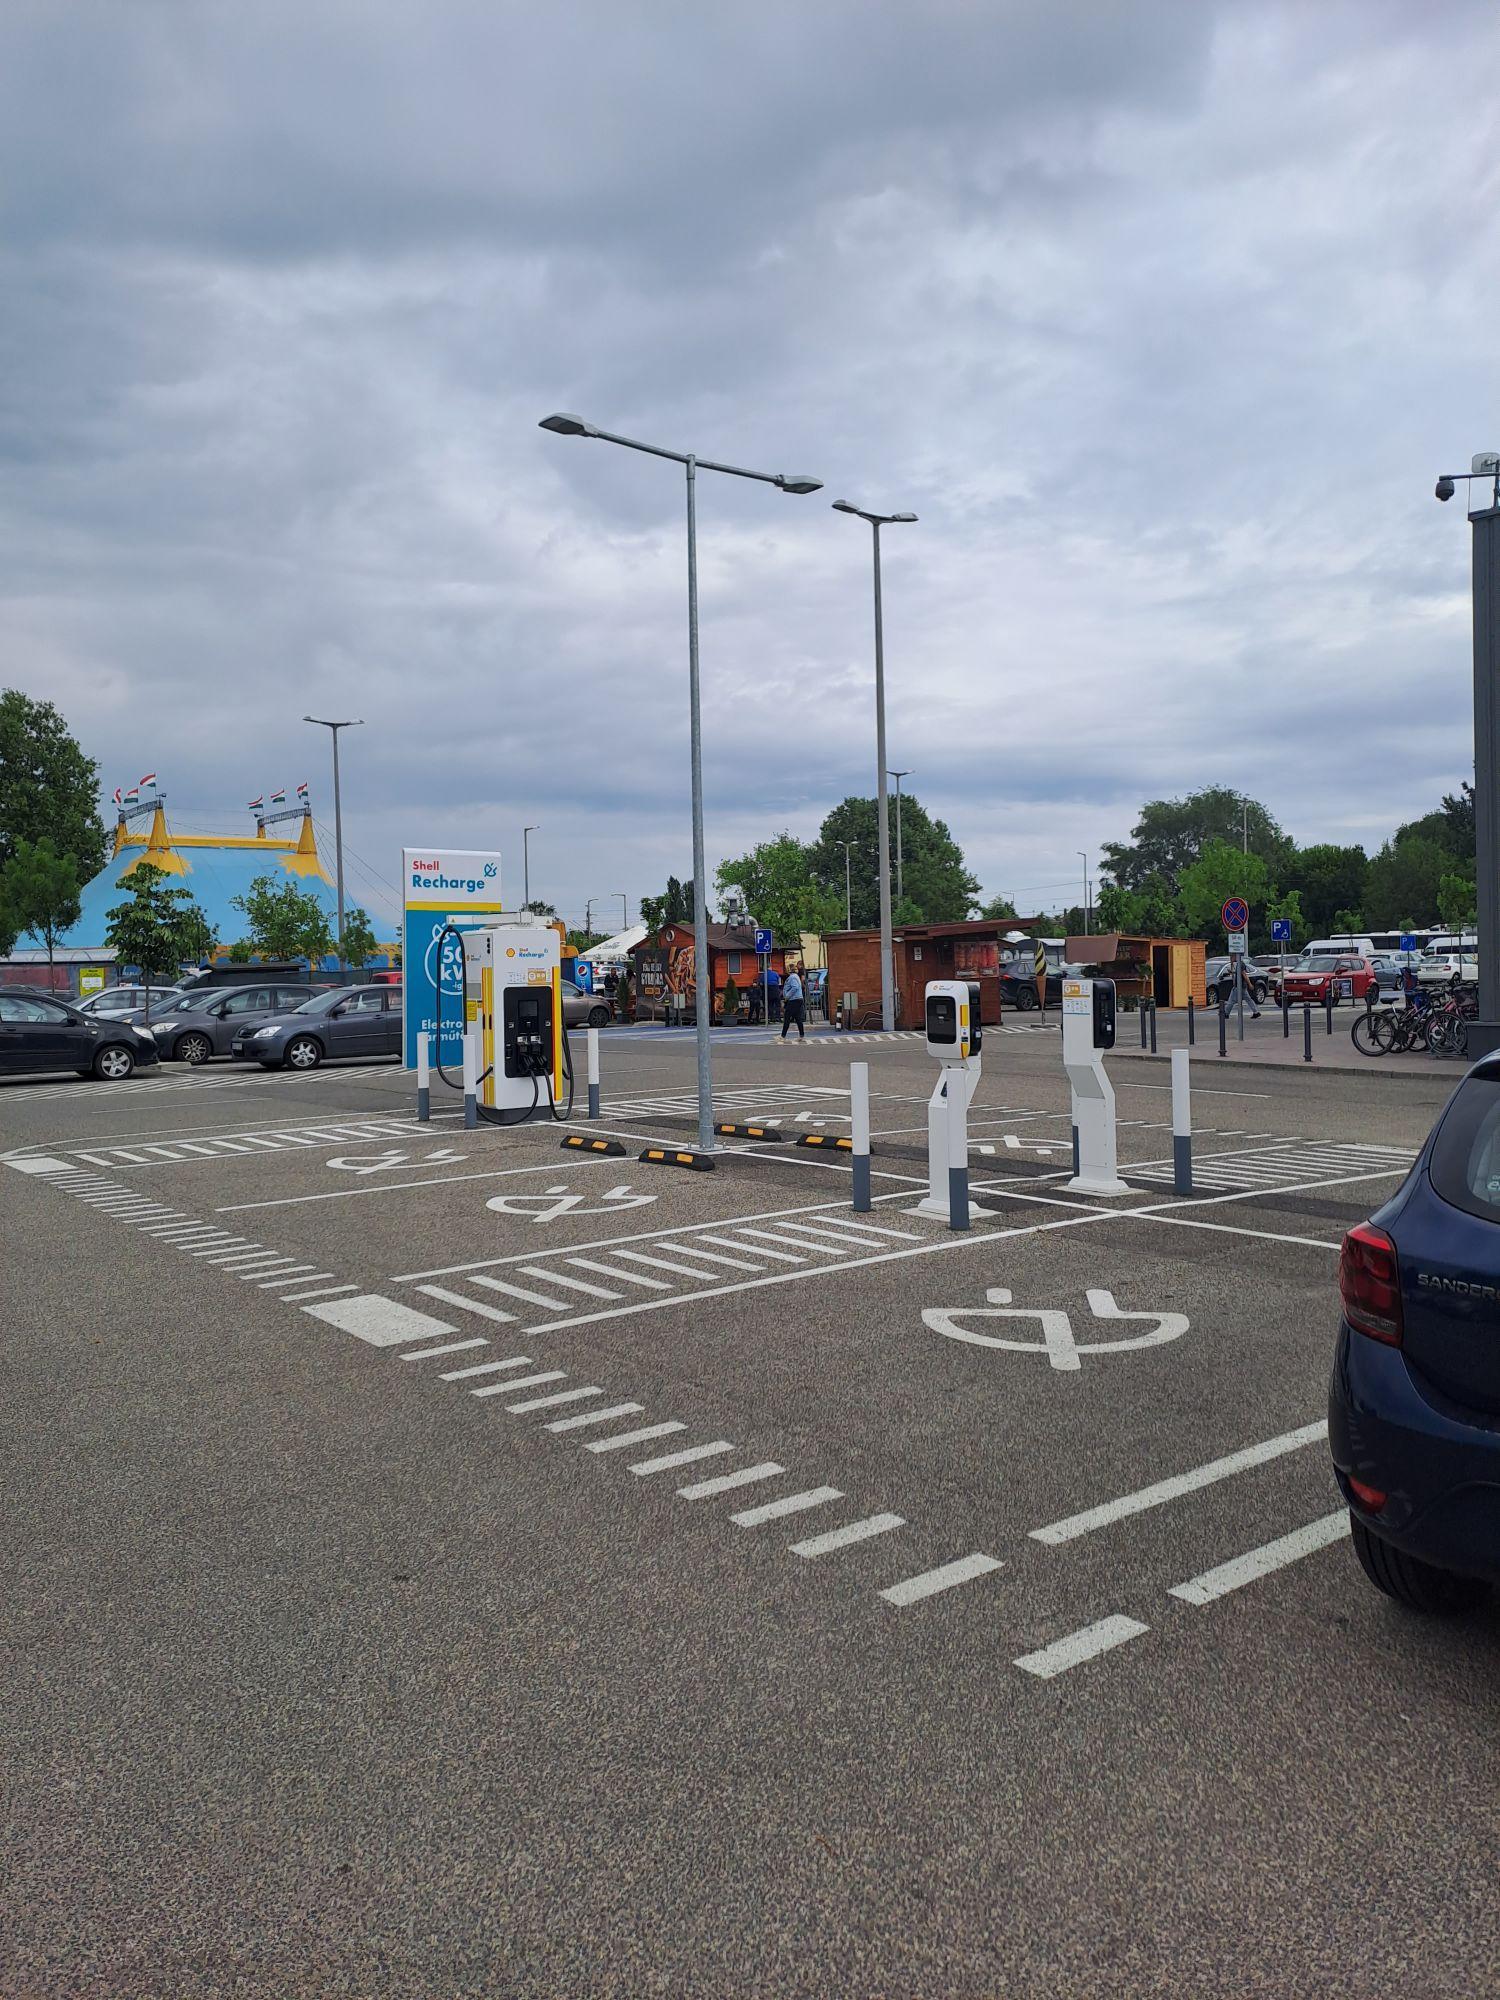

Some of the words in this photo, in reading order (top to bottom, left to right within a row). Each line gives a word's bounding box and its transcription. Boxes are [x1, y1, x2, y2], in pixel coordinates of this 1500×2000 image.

[412, 860, 440, 871] Shell
[412, 874, 485, 893] Recharge
[1273, 922, 1281, 933] P
[757, 932, 764, 944] P
[421, 1019, 463, 1030] Elektro
[1418, 1273, 1500, 1300] SANDER
